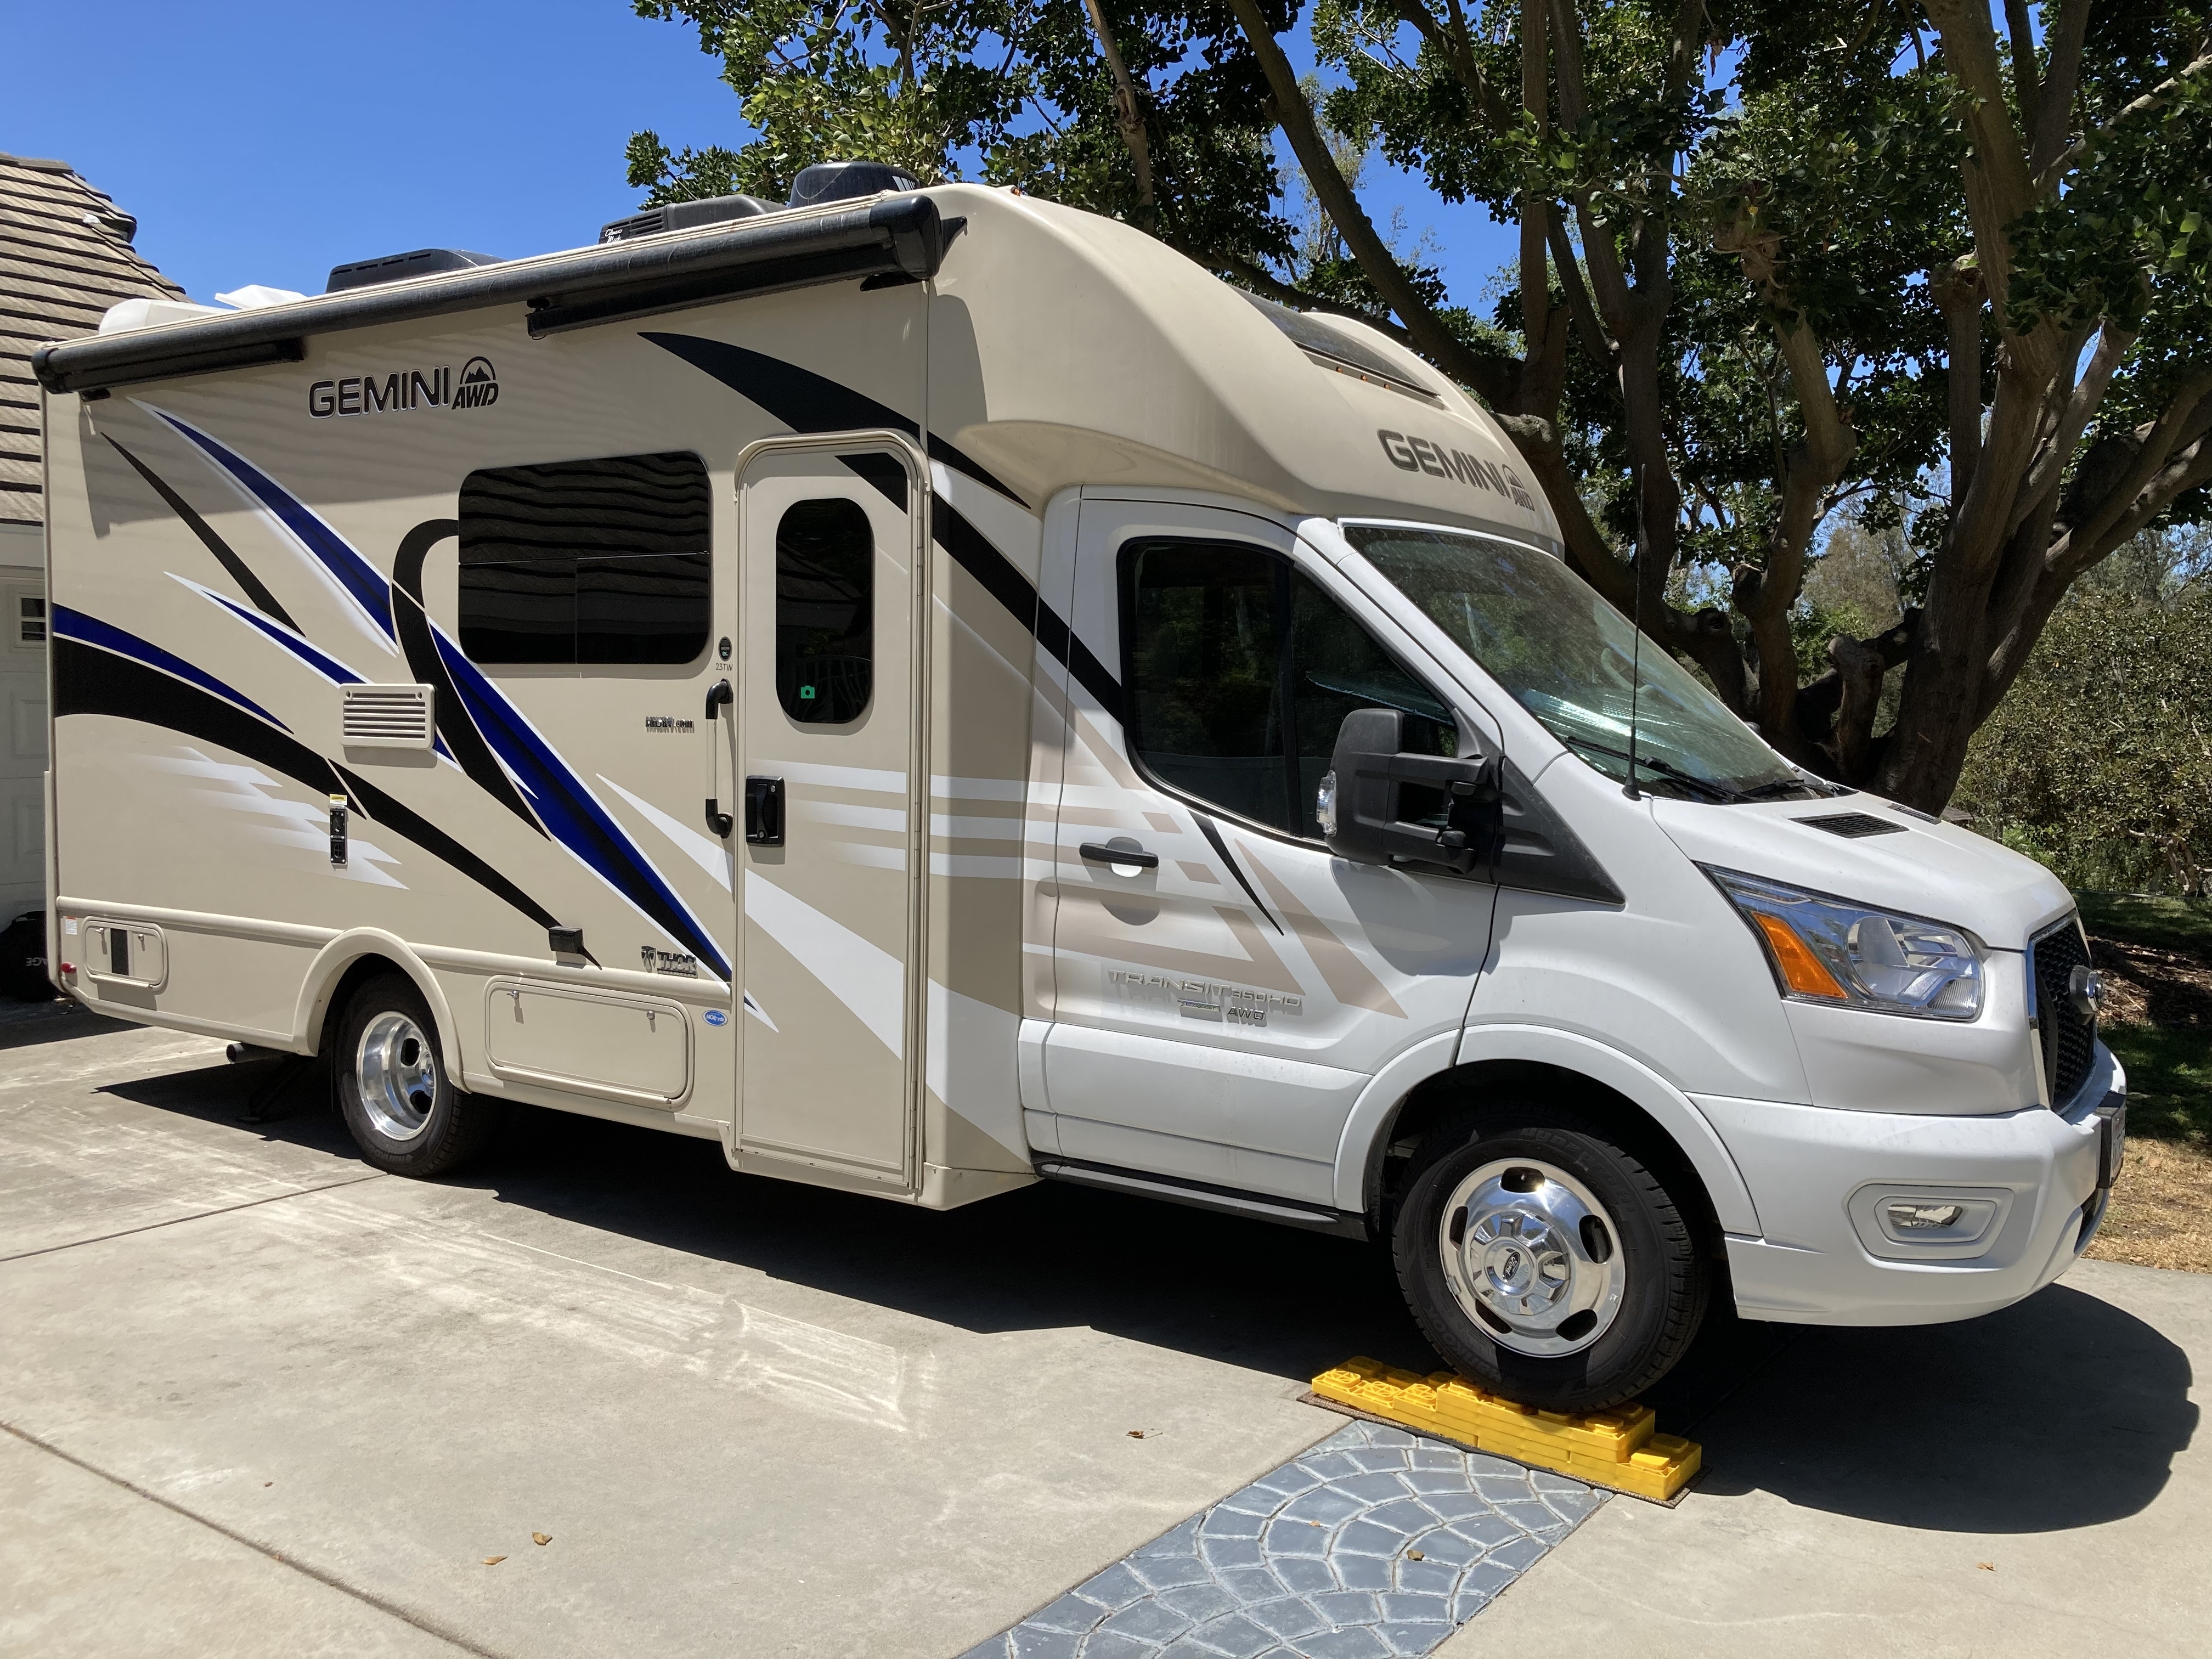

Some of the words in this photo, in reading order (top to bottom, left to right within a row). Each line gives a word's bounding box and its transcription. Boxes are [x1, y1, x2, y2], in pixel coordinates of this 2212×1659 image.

[308, 366, 450, 419] GEMINI
[452, 382, 499, 410] AWD
[1376, 428, 1512, 500] GEMINI
[1510, 486, 1535, 511] AWD
[715, 663, 733, 672] 23TW
[657, 951, 697, 972] THOR
[1107, 969, 1231, 996] TRANSIT
[1230, 989, 1302, 1007] 350HD
[1227, 1006, 1266, 1020] AWD
[1505, 1256, 1518, 1276] Ford
